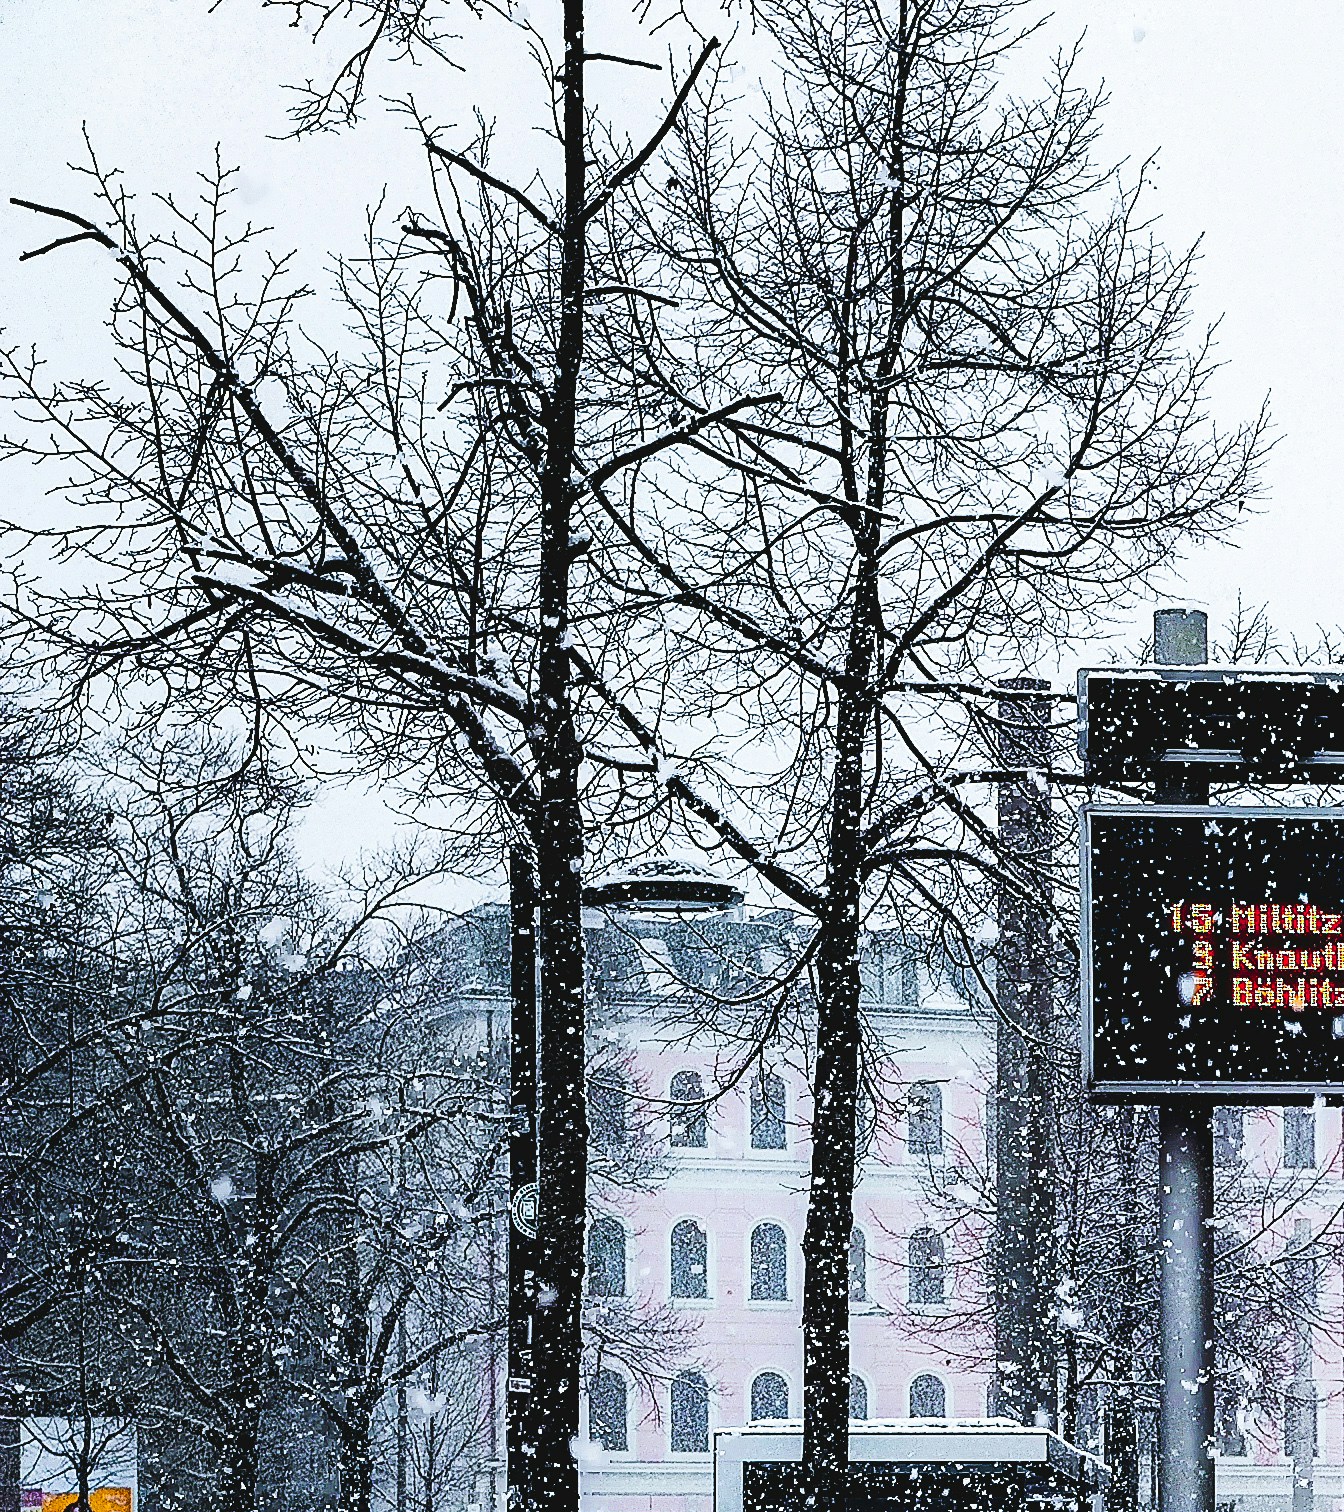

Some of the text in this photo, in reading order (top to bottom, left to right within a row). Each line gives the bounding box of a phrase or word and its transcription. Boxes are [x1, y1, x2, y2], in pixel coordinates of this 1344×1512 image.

[1171, 903, 1213, 934] 15
[1232, 903, 1342, 935] Miltitz
[1191, 976, 1213, 1006] 7
